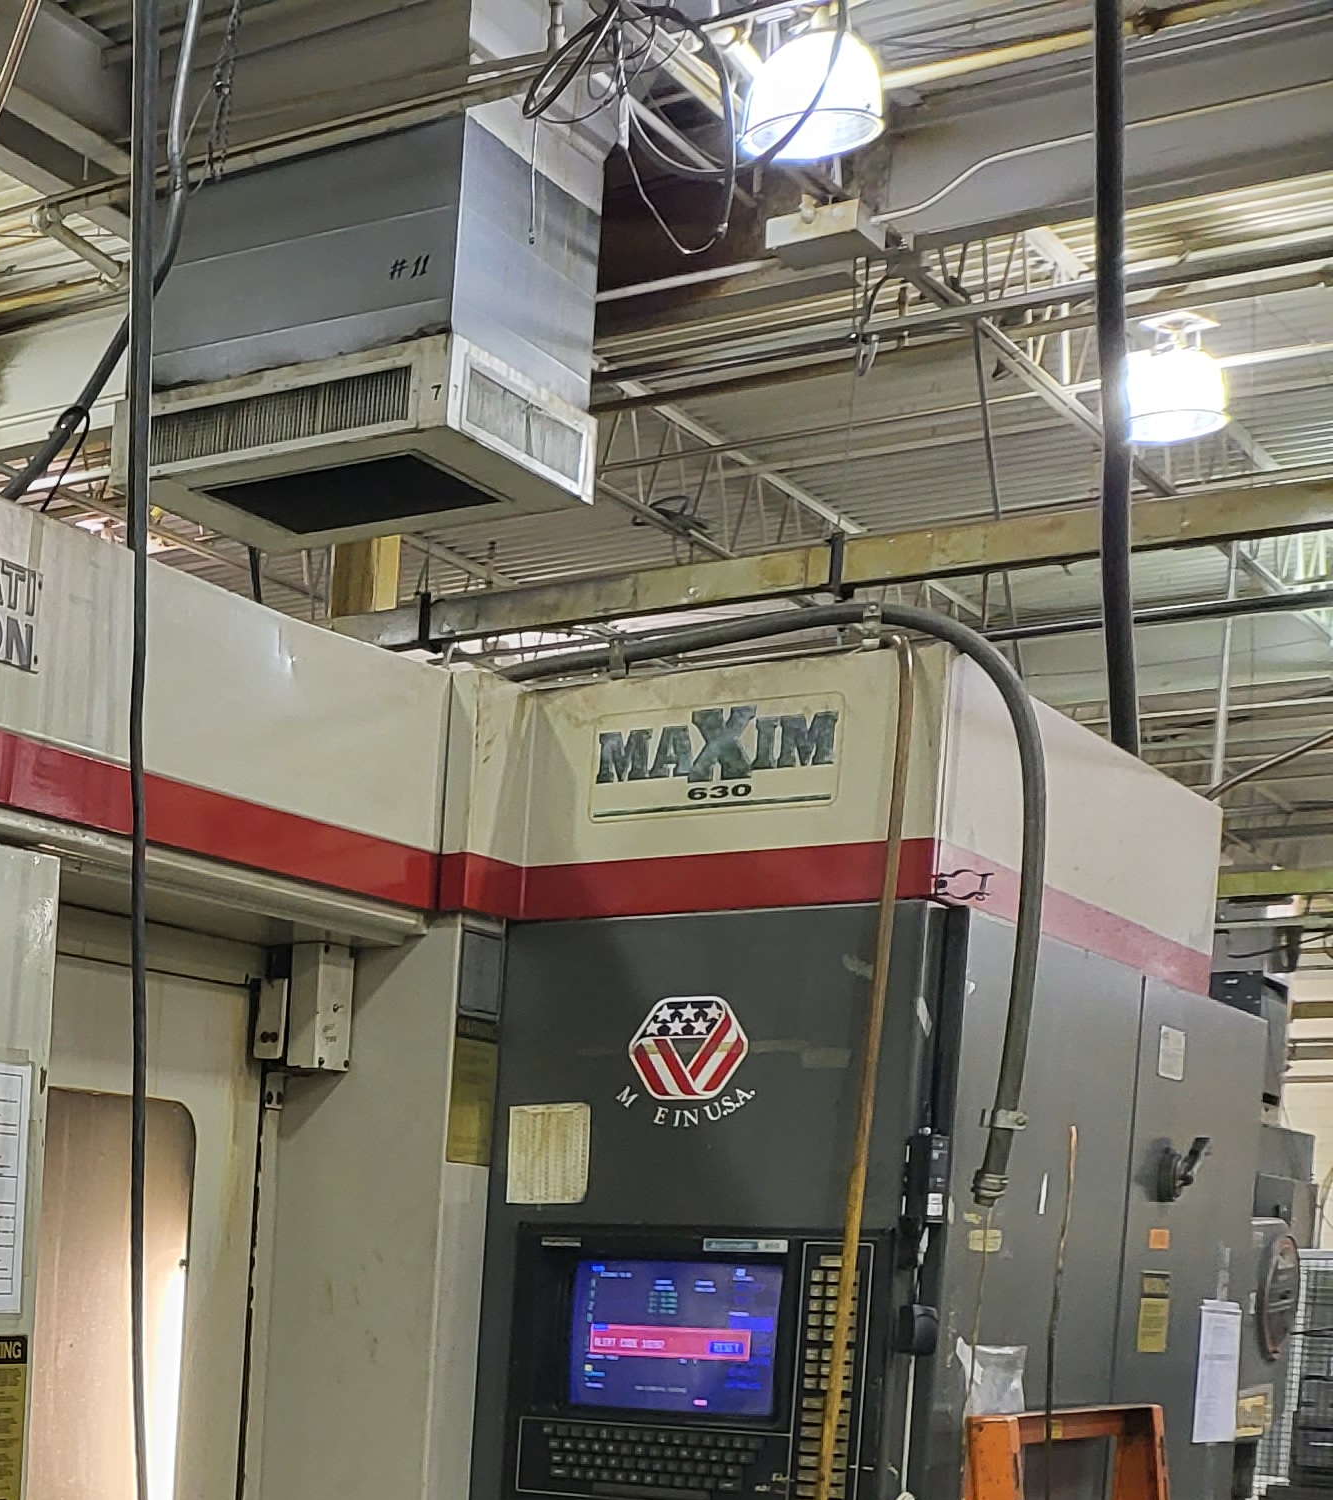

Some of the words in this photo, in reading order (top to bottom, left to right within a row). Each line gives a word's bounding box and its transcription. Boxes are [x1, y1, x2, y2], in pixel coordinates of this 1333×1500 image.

[431, 384, 442, 401] 7
[595, 705, 840, 785] MAXIM
[687, 783, 753, 801] 630
